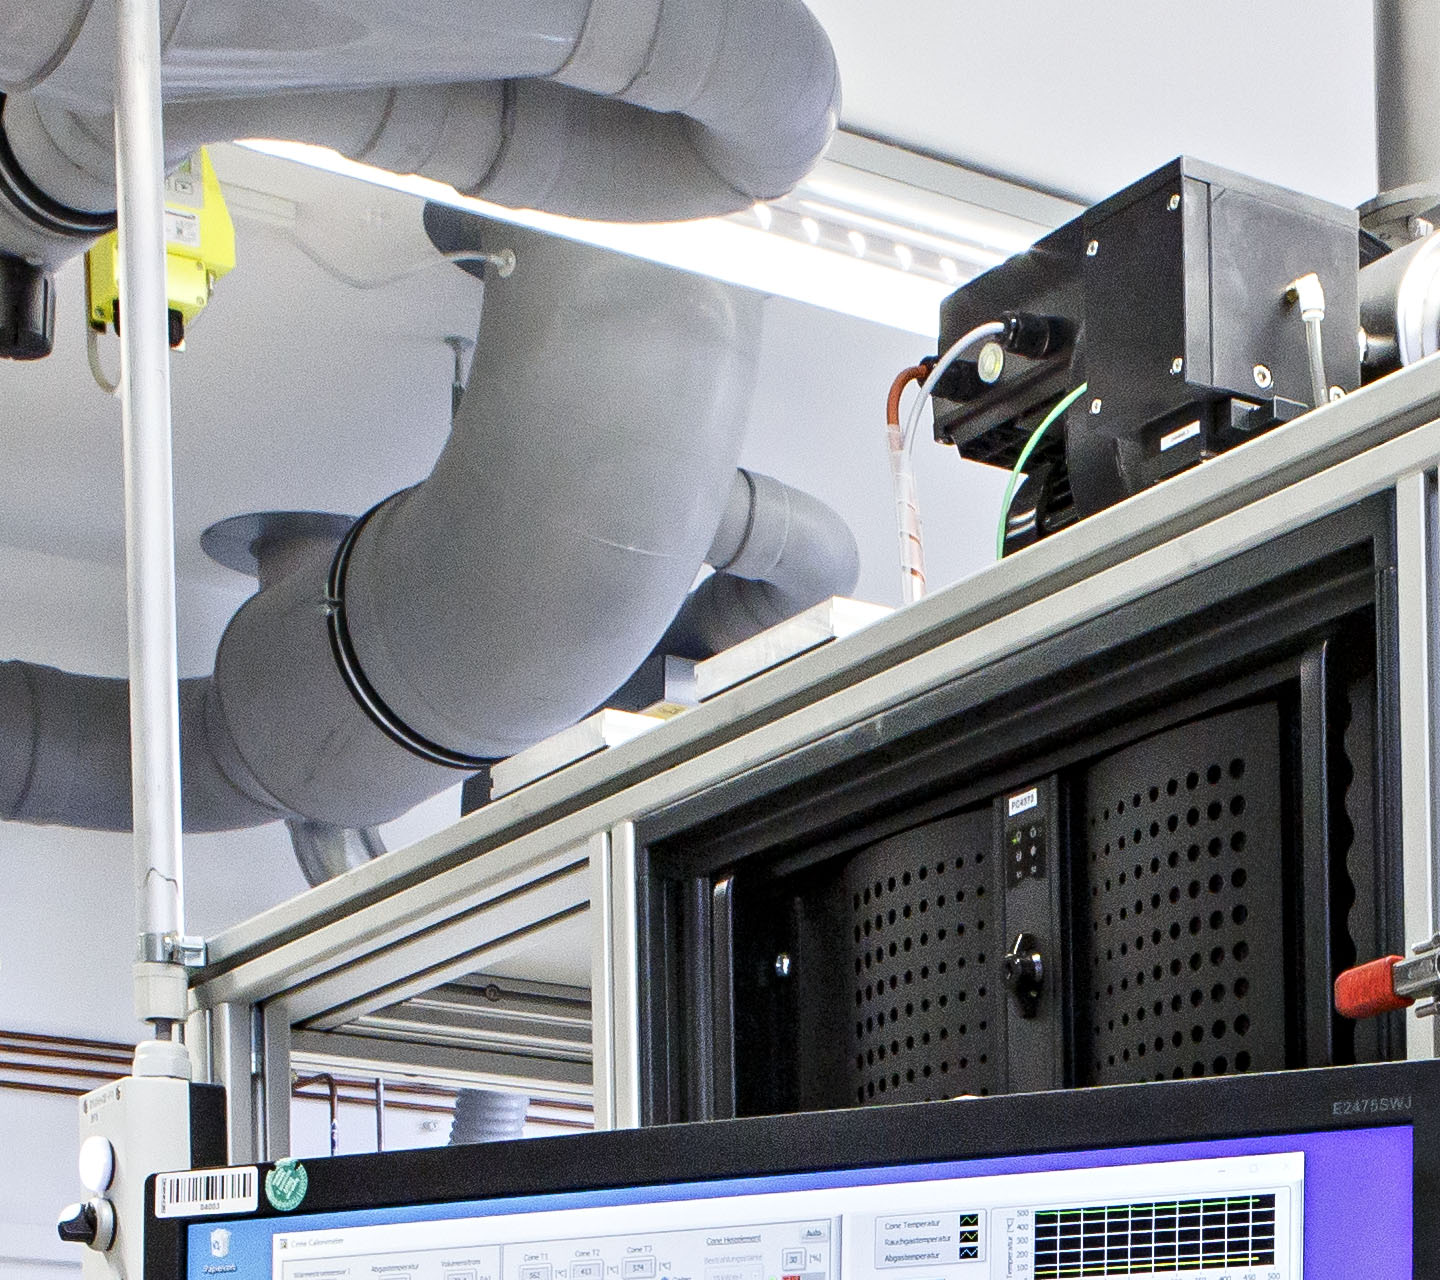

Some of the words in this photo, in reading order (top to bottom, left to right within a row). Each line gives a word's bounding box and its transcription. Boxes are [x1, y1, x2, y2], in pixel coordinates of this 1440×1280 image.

[903, 1220, 941, 1228] Temperatur
[885, 1235, 951, 1246] Rauchgastemperatur
[885, 1252, 940, 1263] Abgastemperatur
